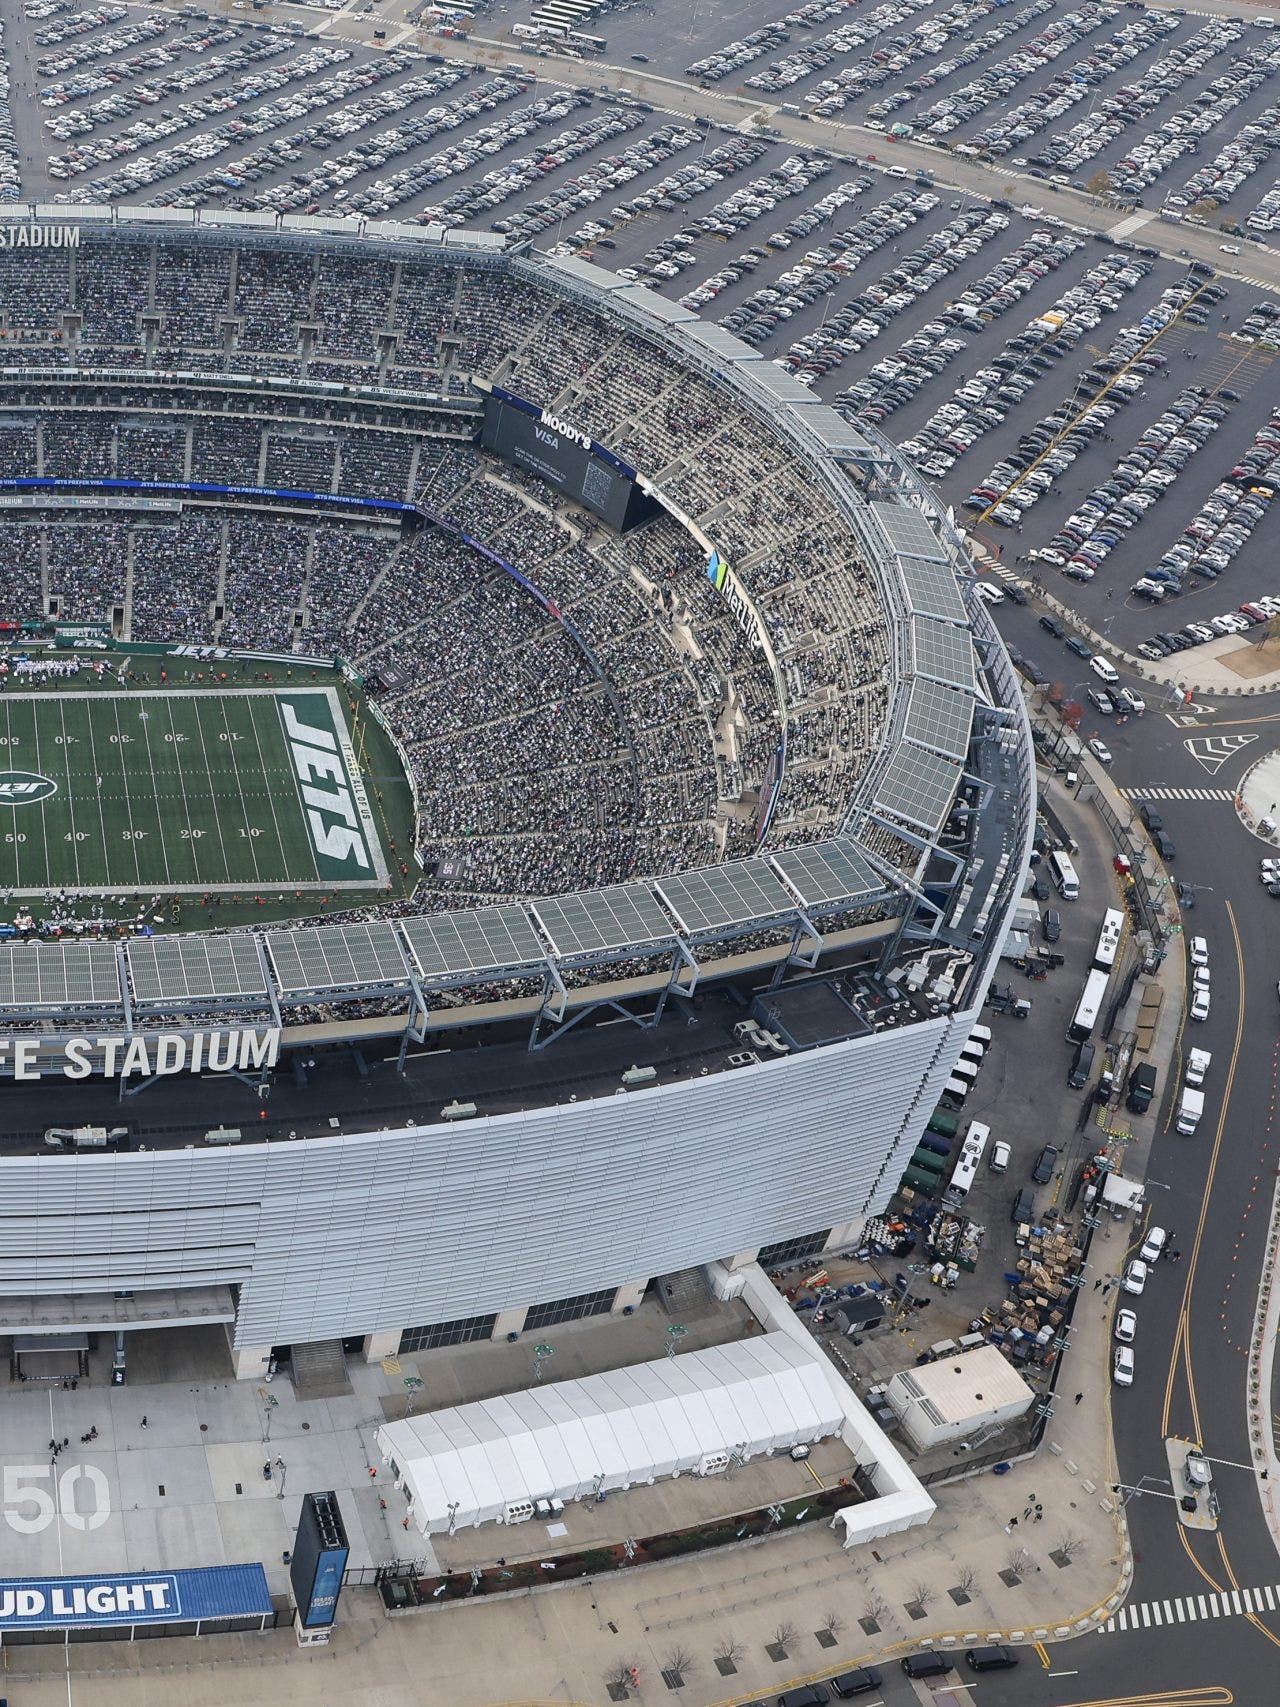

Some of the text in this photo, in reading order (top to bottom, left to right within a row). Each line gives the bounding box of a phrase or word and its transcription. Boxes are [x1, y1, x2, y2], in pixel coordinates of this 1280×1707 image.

[404, 390, 428, 398] WALKER
[540, 411, 592, 450] MOODY'S
[534, 426, 559, 450] VISA
[328, 495, 349, 503] PREFER
[350, 497, 364, 505] VISA
[401, 503, 416, 511] JETS
[722, 574, 761, 650] MetLife
[171, 645, 230, 659] JETS
[0, 736, 20, 746] 50
[55, 735, 74, 745] 40
[110, 734, 129, 743] 30
[164, 733, 184, 743] 20
[219, 732, 239, 742] 10
[342, 743, 352, 752] IT
[281, 703, 369, 868] JETS
[352, 778, 365, 795] ALL
[357, 795, 367, 808] OF
[361, 808, 371, 821] US
[5, 833, 27, 843] 50
[63, 832, 85, 842] 40
[122, 830, 144, 841] 30
[180, 829, 202, 839] 20
[238, 828, 260, 838] 10
[63, 1028, 280, 1079] STADIUM
[3, 1464, 110, 1534] 50
[51, 1583, 171, 1616] LIGHT
